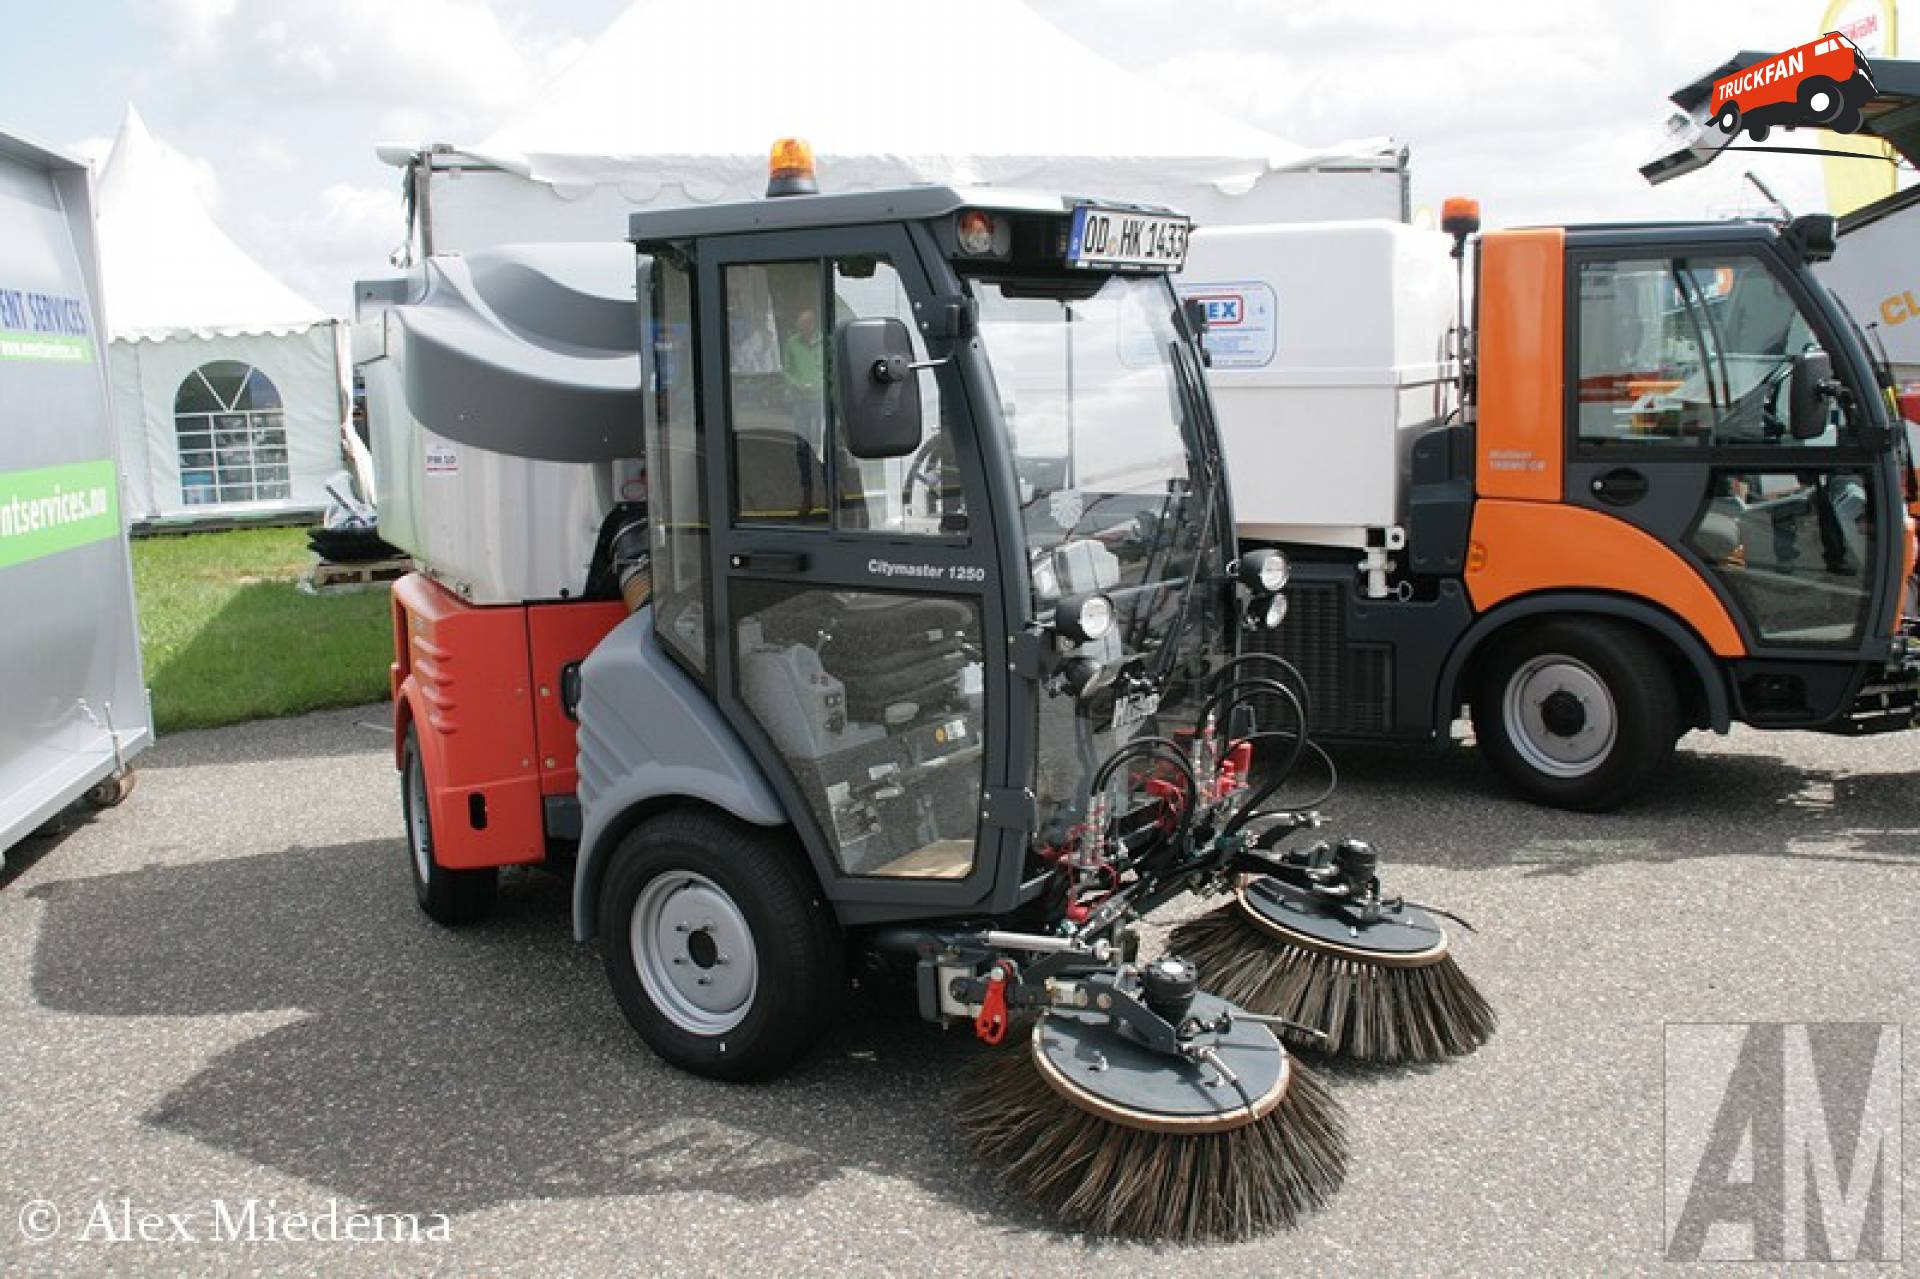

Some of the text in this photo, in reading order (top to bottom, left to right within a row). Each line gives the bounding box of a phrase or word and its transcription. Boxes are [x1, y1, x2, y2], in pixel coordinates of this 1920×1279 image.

[1084, 215, 1187, 259] OD HK 1433
[28, 292, 87, 335] SERVICES
[868, 558, 985, 581] Citymaster 1250
